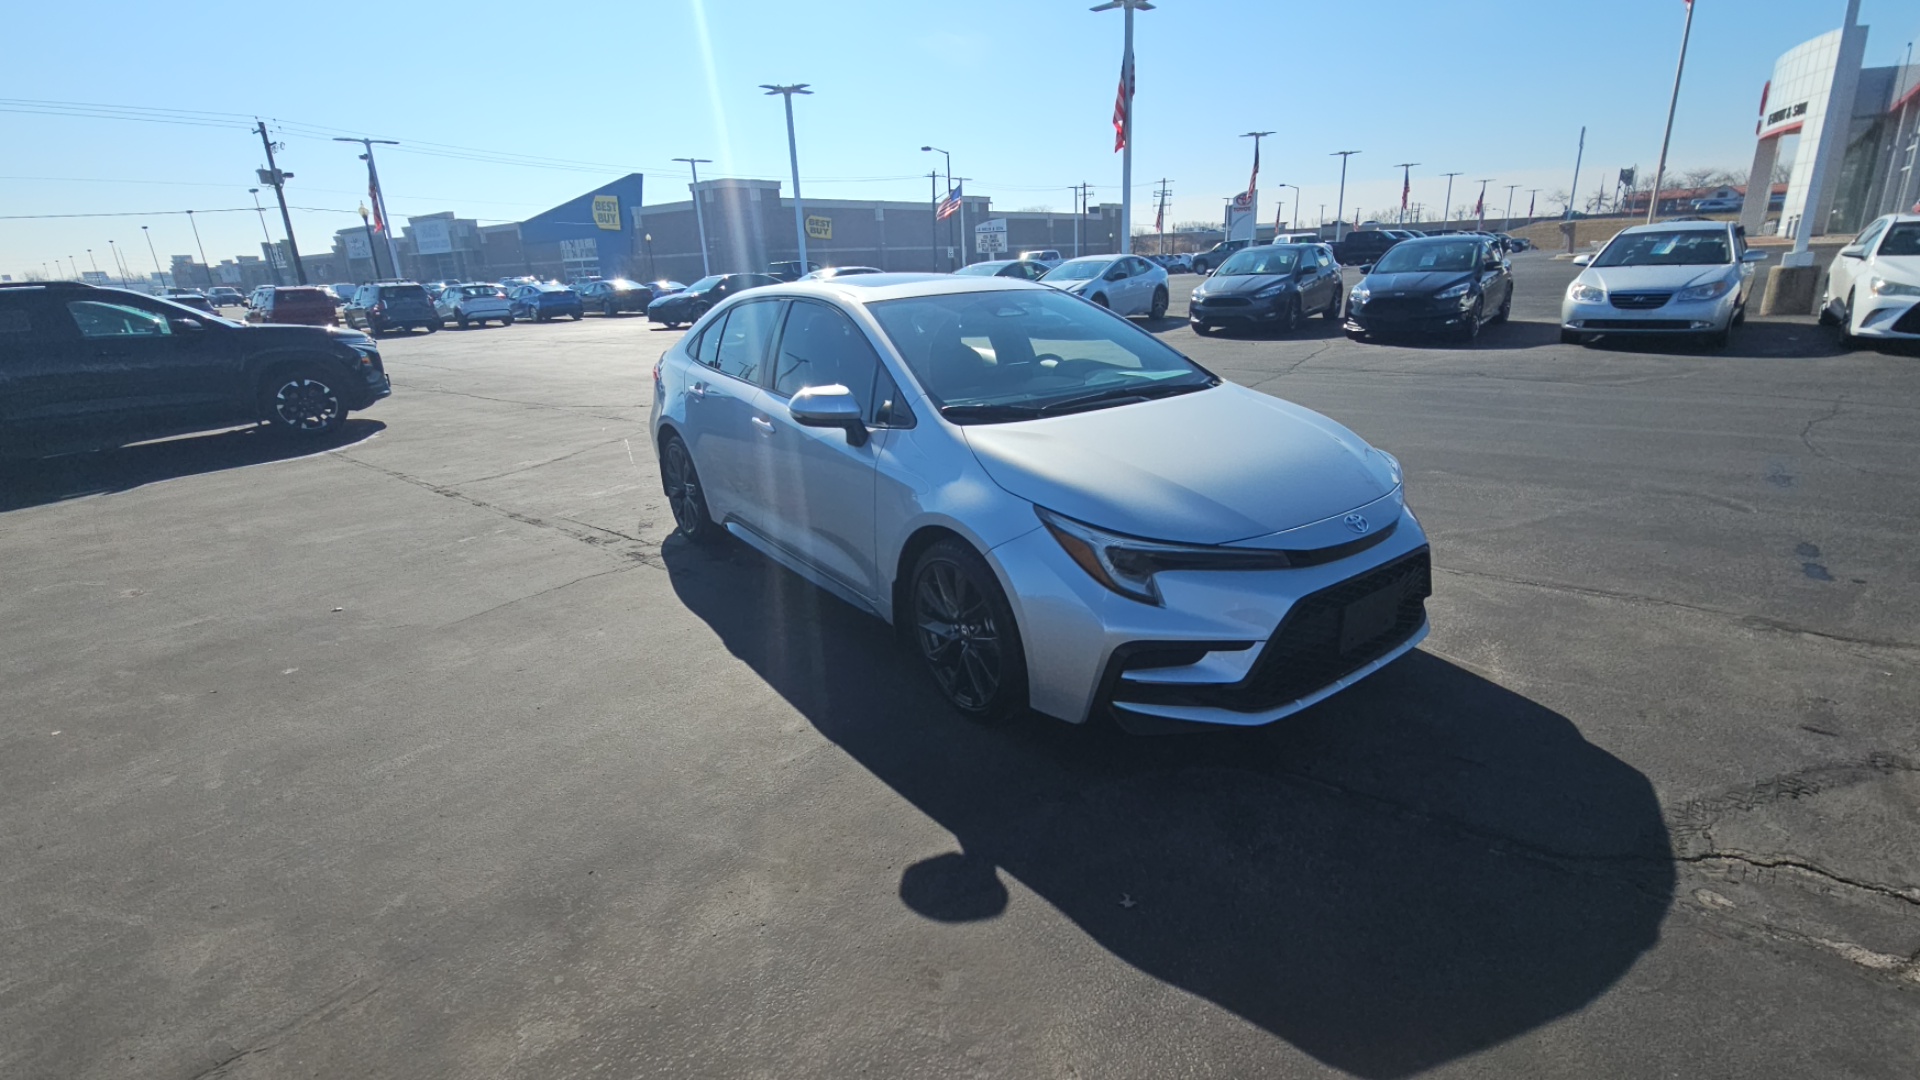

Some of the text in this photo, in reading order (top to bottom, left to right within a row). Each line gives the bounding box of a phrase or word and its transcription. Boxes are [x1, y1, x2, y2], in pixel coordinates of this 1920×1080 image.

[594, 200, 617, 212] BEST
[597, 212, 616, 224] BUY
[808, 219, 830, 228] BEST
[810, 226, 828, 235] BUY
